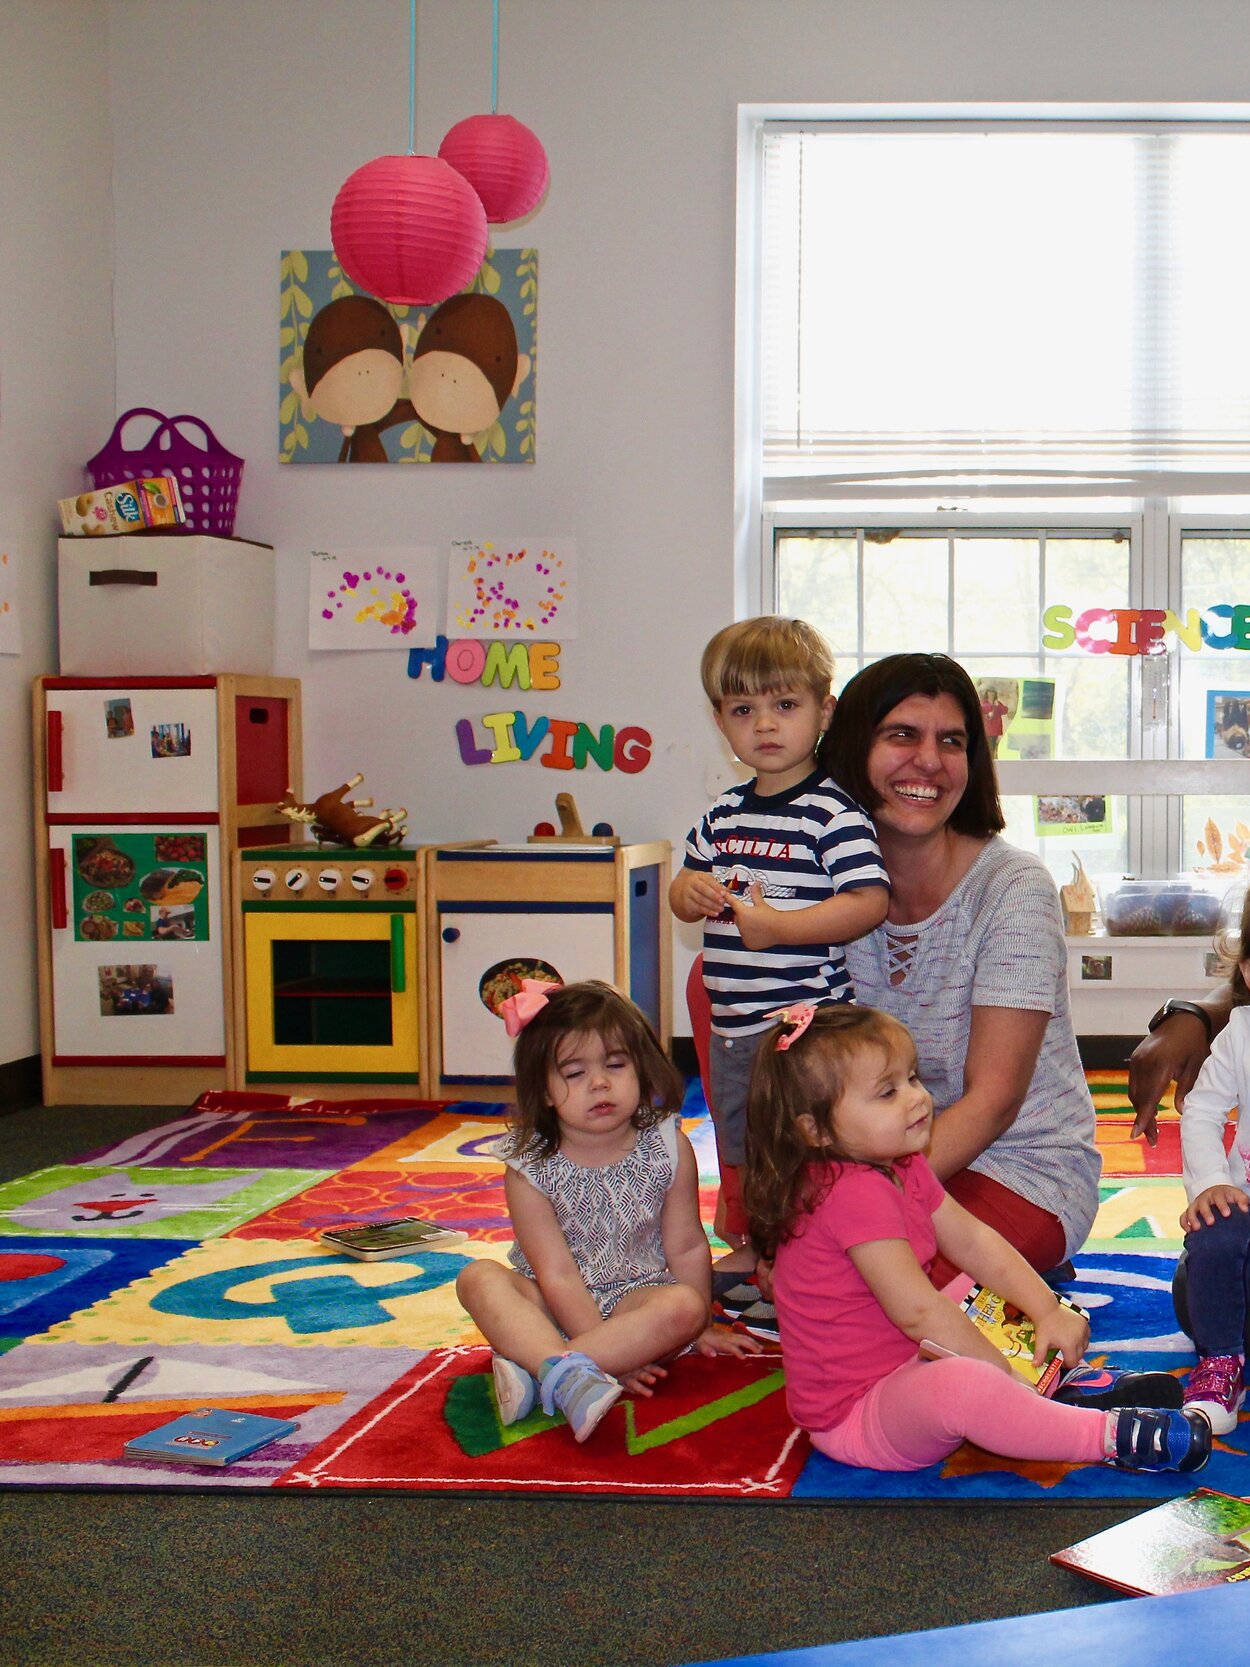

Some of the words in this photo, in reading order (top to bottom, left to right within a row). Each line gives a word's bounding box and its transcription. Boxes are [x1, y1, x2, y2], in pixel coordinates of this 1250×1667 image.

[104, 491, 119, 531] Cashew
[116, 493, 139, 522] Silk
[407, 634, 561, 690] HOME
[455, 710, 652, 774] LIVING
